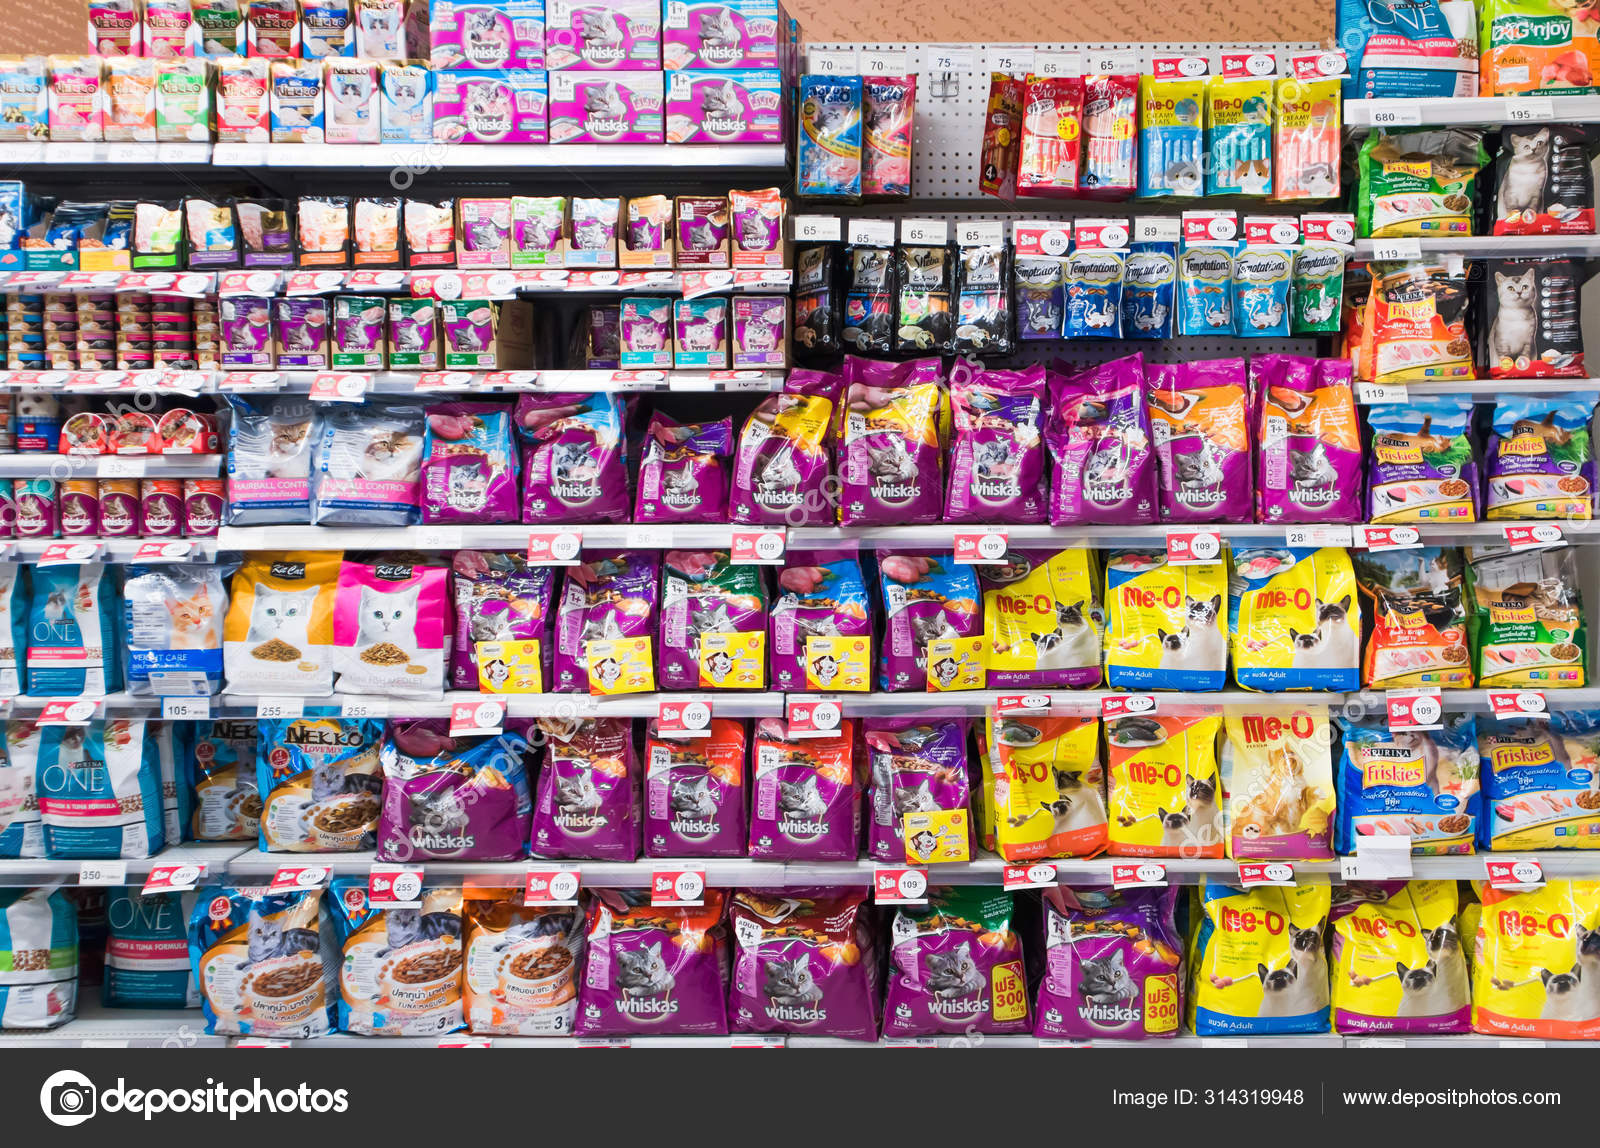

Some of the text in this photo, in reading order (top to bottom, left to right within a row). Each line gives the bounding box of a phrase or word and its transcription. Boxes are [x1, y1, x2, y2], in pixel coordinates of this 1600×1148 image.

[465, 47, 509, 60] whiskas
[581, 47, 625, 60] whiskas
[698, 47, 743, 60] whiskas
[820, 61, 833, 70] 70
[871, 61, 883, 70] 70
[937, 58, 951, 68] 75
[999, 58, 1012, 68] 75
[1100, 60, 1114, 70] 65
[1501, 57, 1528, 65] Adult
[1044, 63, 1057, 73] 65
[1375, 112, 1395, 121] 680
[1511, 110, 1530, 119] 195
[467, 119, 511, 132] whiskas
[584, 119, 628, 132] whiskas
[701, 119, 746, 132] whiskas
[803, 226, 816, 235] 65
[911, 230, 924, 239] 65
[966, 231, 979, 240] 65
[1144, 227, 1157, 237] 89
[1216, 226, 1228, 234] 69
[1280, 229, 1291, 238] 69
[857, 234, 870, 243] 65
[1108, 233, 1120, 241] 69
[1379, 250, 1398, 259] 119
[1186, 257, 1230, 272] Temptations
[1365, 389, 1384, 398] 119
[551, 484, 602, 498] whiskas
[871, 484, 921, 499] whiskas
[970, 482, 1021, 498] whiskas
[1083, 486, 1133, 501] whiskas
[1176, 488, 1227, 503] whiskas
[1289, 488, 1340, 502] whiskas
[662, 494, 701, 505] whiskas
[753, 491, 804, 505] whiskas
[1291, 533, 1304, 543] 28
[759, 542, 775, 551] 109
[983, 542, 998, 551] 109
[1195, 542, 1210, 551] 109
[376, 564, 412, 576] Kit Cat
[1124, 586, 1180, 609] me-O
[1257, 588, 1312, 611] me-O
[996, 593, 1052, 615] me-O
[33, 622, 76, 642] ONE
[1013, 672, 1031, 681] Adult
[1268, 671, 1286, 680] Adult
[168, 706, 187, 716] 105
[261, 706, 281, 717] 255
[347, 706, 367, 716] 255
[686, 712, 702, 721] 109
[1416, 706, 1432, 715] 109
[816, 713, 831, 721] 109
[1242, 710, 1314, 744] me-O
[286, 725, 364, 746] NEKKO
[1371, 749, 1411, 758] PURINA
[1495, 748, 1551, 766] Friskies
[654, 755, 667, 765] 1+
[762, 755, 775, 765] 1+
[43, 764, 105, 792] ONE
[1129, 761, 1182, 787] me-O
[1366, 765, 1422, 782] Friskies
[670, 820, 720, 835] whiskas
[778, 820, 829, 835] whiskas
[411, 835, 475, 850] whiskas
[82, 870, 101, 880] 350
[1007, 869, 1025, 879] Sale
[1116, 867, 1133, 878] Sale
[396, 883, 412, 892] 255
[530, 878, 570, 892] Sale 109
[655, 878, 695, 892] Sale 109
[902, 880, 917, 890] 109
[109, 897, 173, 933] ONE
[1221, 905, 1285, 935] me-O
[738, 919, 760, 931] ADULT
[896, 923, 910, 935] 1+
[1053, 923, 1065, 935] 1+
[1352, 915, 1416, 938] me-O
[1498, 910, 1569, 938] me-O
[740, 927, 754, 940] 1+
[155, 942, 188, 952] FORMULA
[995, 974, 1016, 992] ฟรี
[996, 992, 1024, 1008] 300
[1149, 987, 1170, 1004] ฟรี
[616, 997, 678, 1014] whiskas
[928, 999, 989, 1015] whiskas
[1148, 1003, 1176, 1019] 300
[766, 1005, 827, 1021] whiskas
[1079, 1004, 1140, 1021] whiskas
[437, 1017, 446, 1029] 3
[554, 1016, 563, 1029] 3
[1230, 1021, 1253, 1030] Adult
[1370, 1021, 1394, 1030] Adult
[1511, 1022, 1536, 1032] Adult
[303, 1026, 310, 1039] 3
